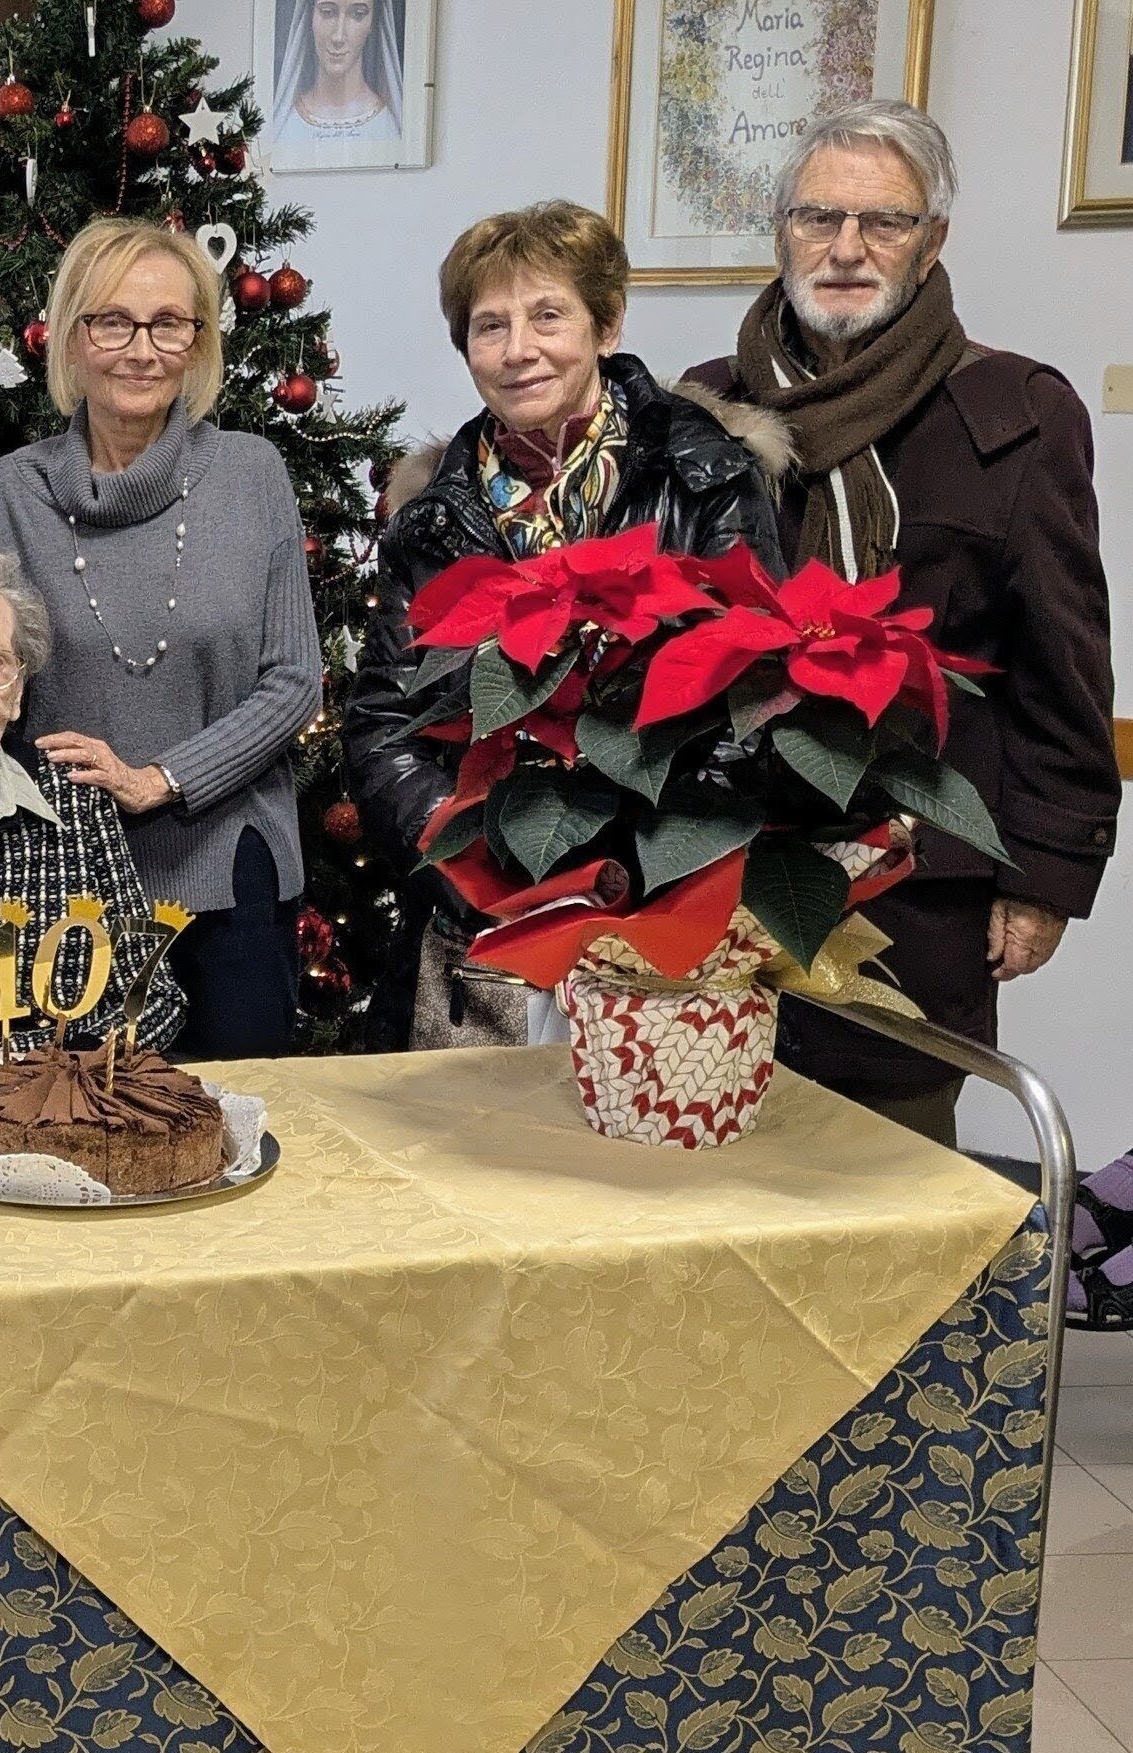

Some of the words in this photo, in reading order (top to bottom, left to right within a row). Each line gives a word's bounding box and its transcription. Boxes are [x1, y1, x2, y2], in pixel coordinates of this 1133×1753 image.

[736, 0, 804, 32] Maria
[724, 45, 808, 81] Regina
[728, 110, 808, 144] Amore
